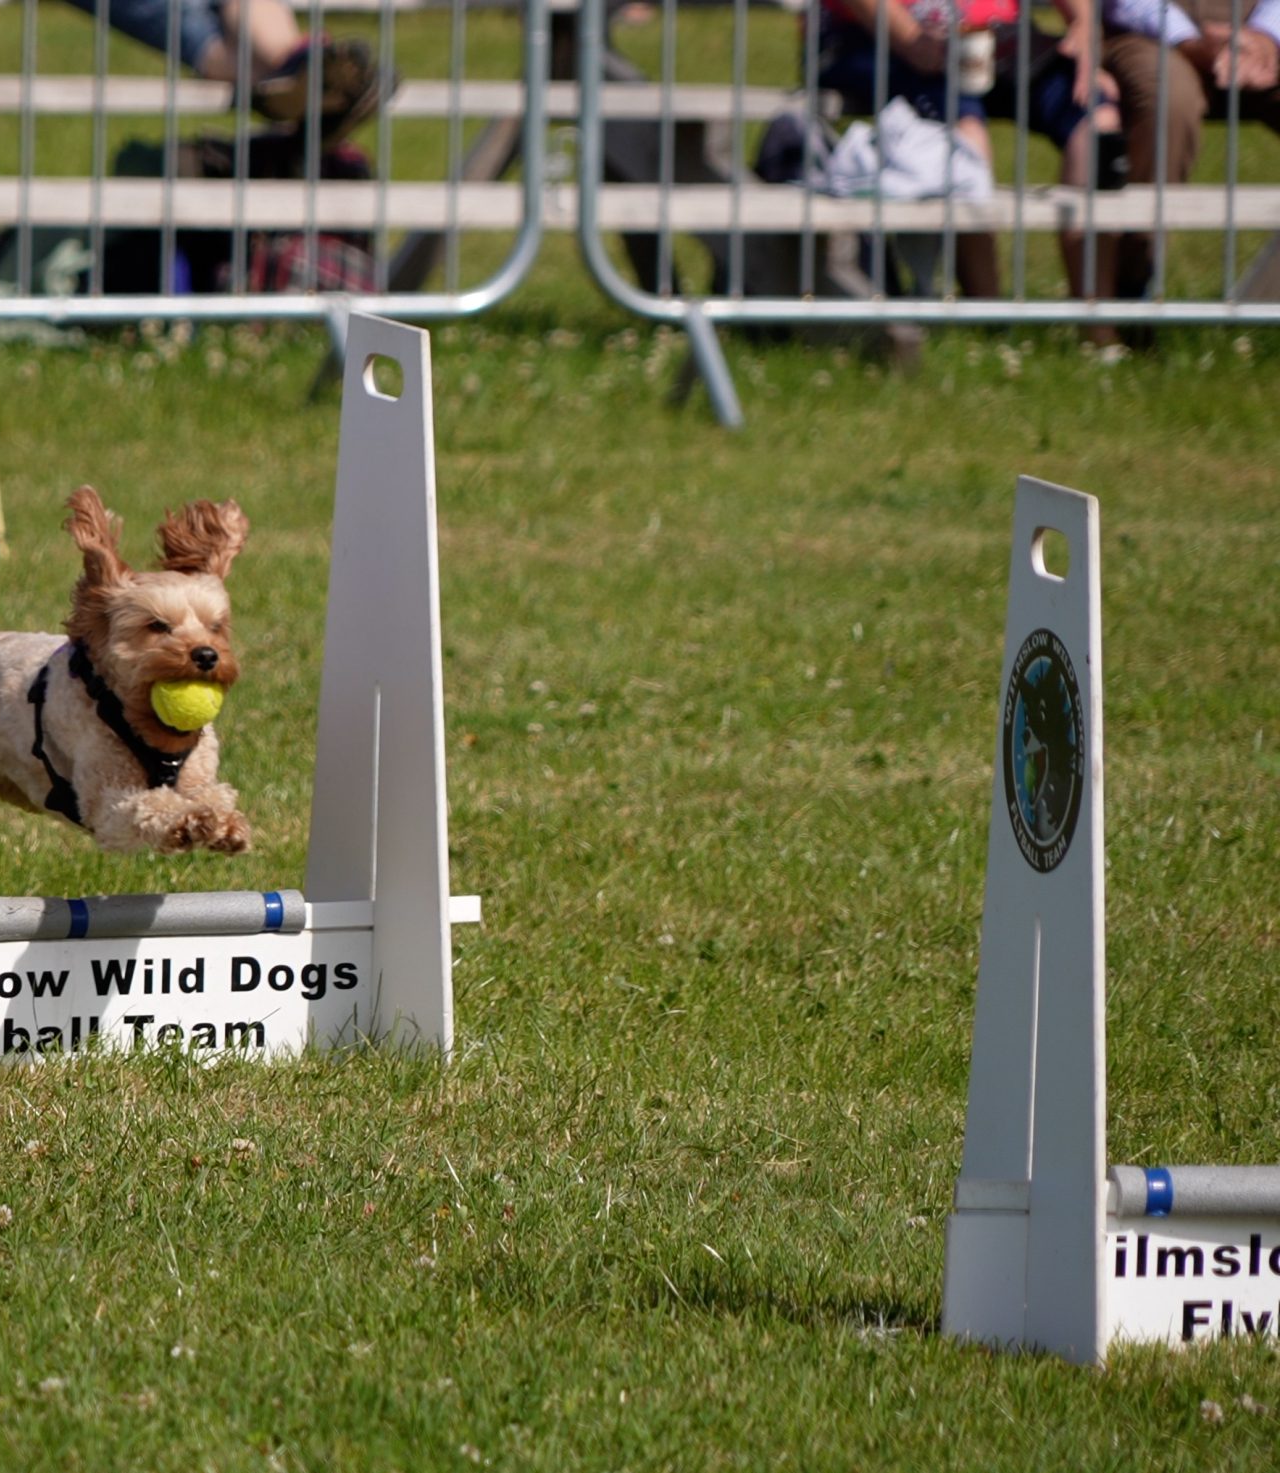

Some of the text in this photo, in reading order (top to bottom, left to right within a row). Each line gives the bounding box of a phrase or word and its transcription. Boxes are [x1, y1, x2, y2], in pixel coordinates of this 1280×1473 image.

[1005, 632, 1049, 726] WILMSLOW
[1052, 637, 1076, 683] WILD
[1010, 801, 1068, 869] FLYBALL TEAM
[91, 957, 205, 996] Wild
[230, 955, 359, 1001] Dogs
[123, 1014, 266, 1050] Team
[1115, 1232, 1280, 1278] ilmsl
[1181, 1299, 1280, 1342] Fly
